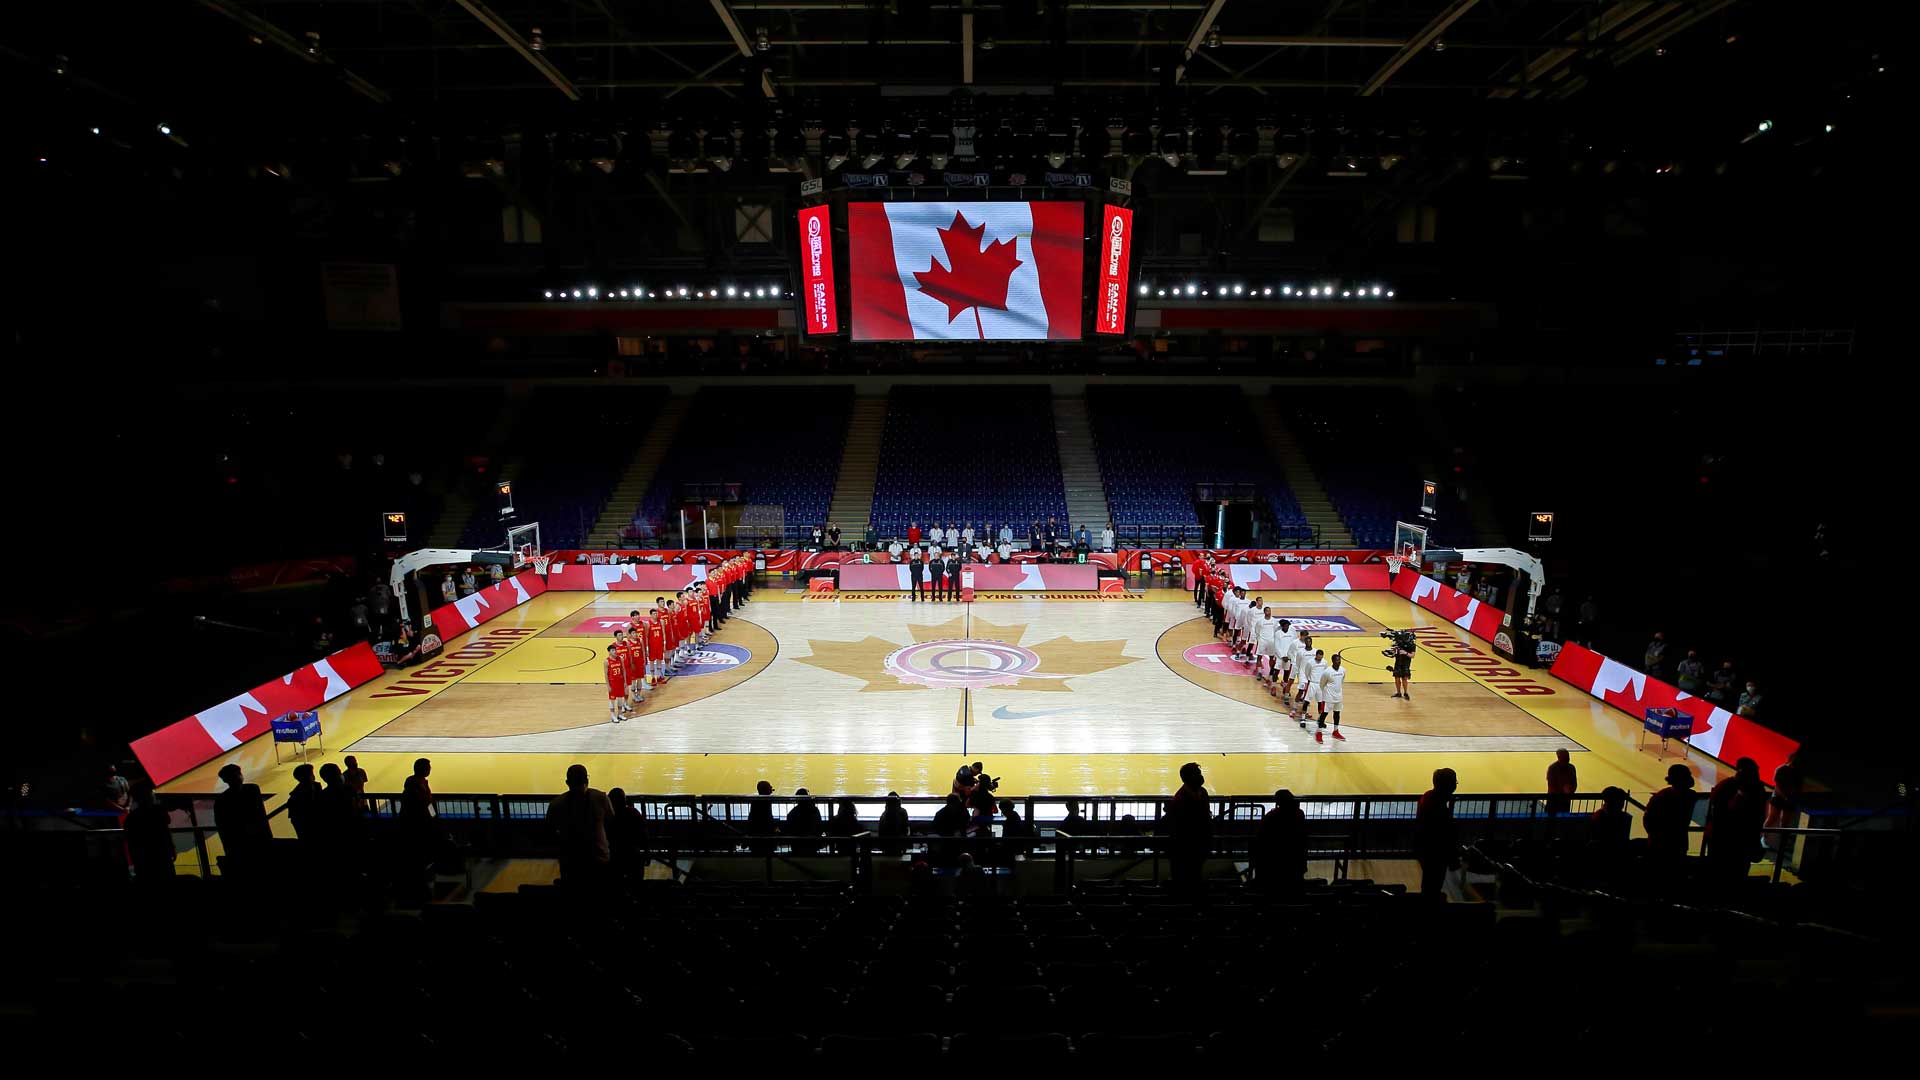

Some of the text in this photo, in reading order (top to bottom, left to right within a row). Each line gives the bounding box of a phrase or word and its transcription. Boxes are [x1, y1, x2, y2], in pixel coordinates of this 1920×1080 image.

[820, 283, 828, 329] CANADA
[1111, 283, 1120, 329] CANADA
[1079, 554, 1085, 563] 0
[369, 628, 539, 699] VICTORIA
[1405, 627, 1555, 696] VICTORIA
